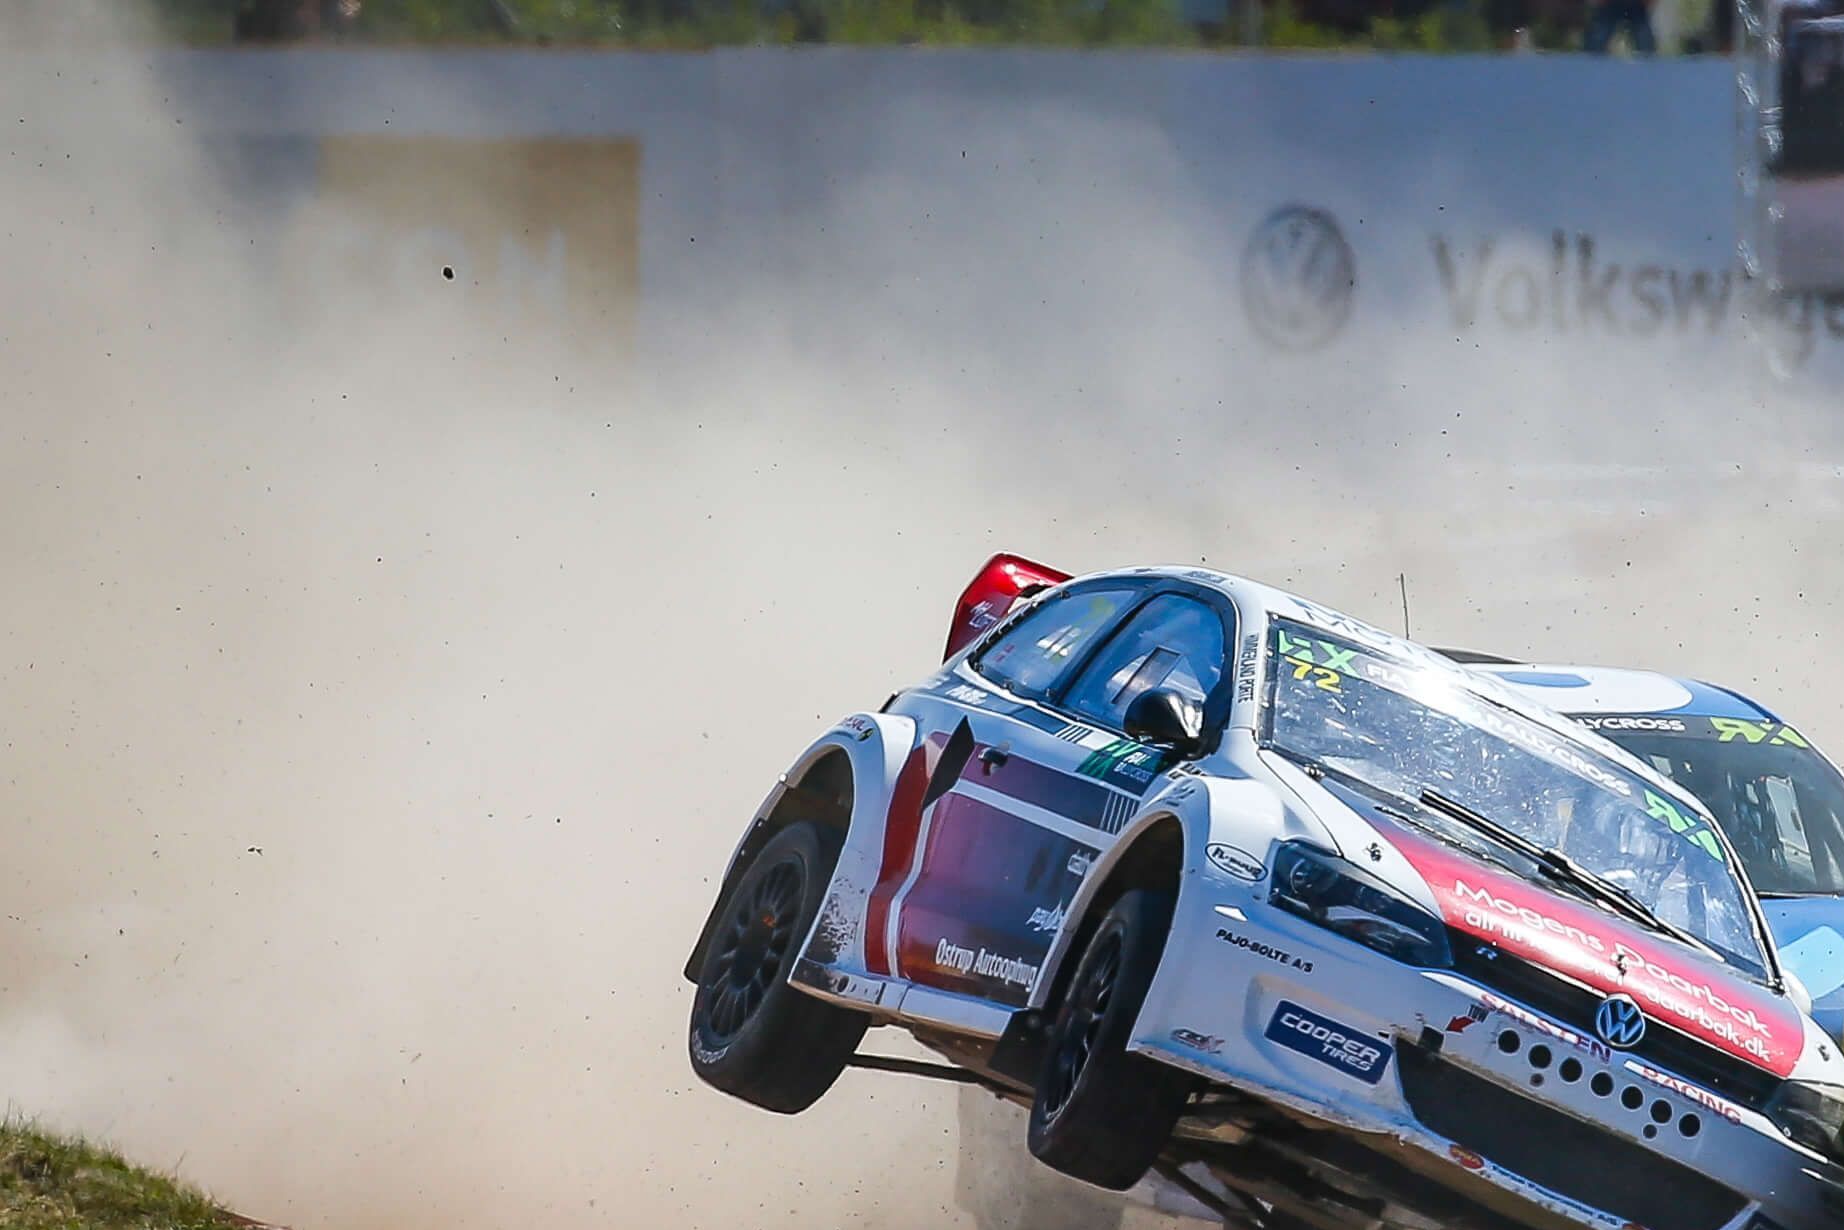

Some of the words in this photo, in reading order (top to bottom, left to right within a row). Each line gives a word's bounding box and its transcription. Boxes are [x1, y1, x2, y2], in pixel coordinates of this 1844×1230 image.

[1284, 655, 1343, 695] 72
[1575, 716, 1686, 732] LYCROSS
[1454, 878, 1607, 951] Mogens
[1614, 941, 1774, 1039] Daarbak
[1279, 1011, 1381, 1064] COOPER
[1320, 1042, 1374, 1072] TIRES
